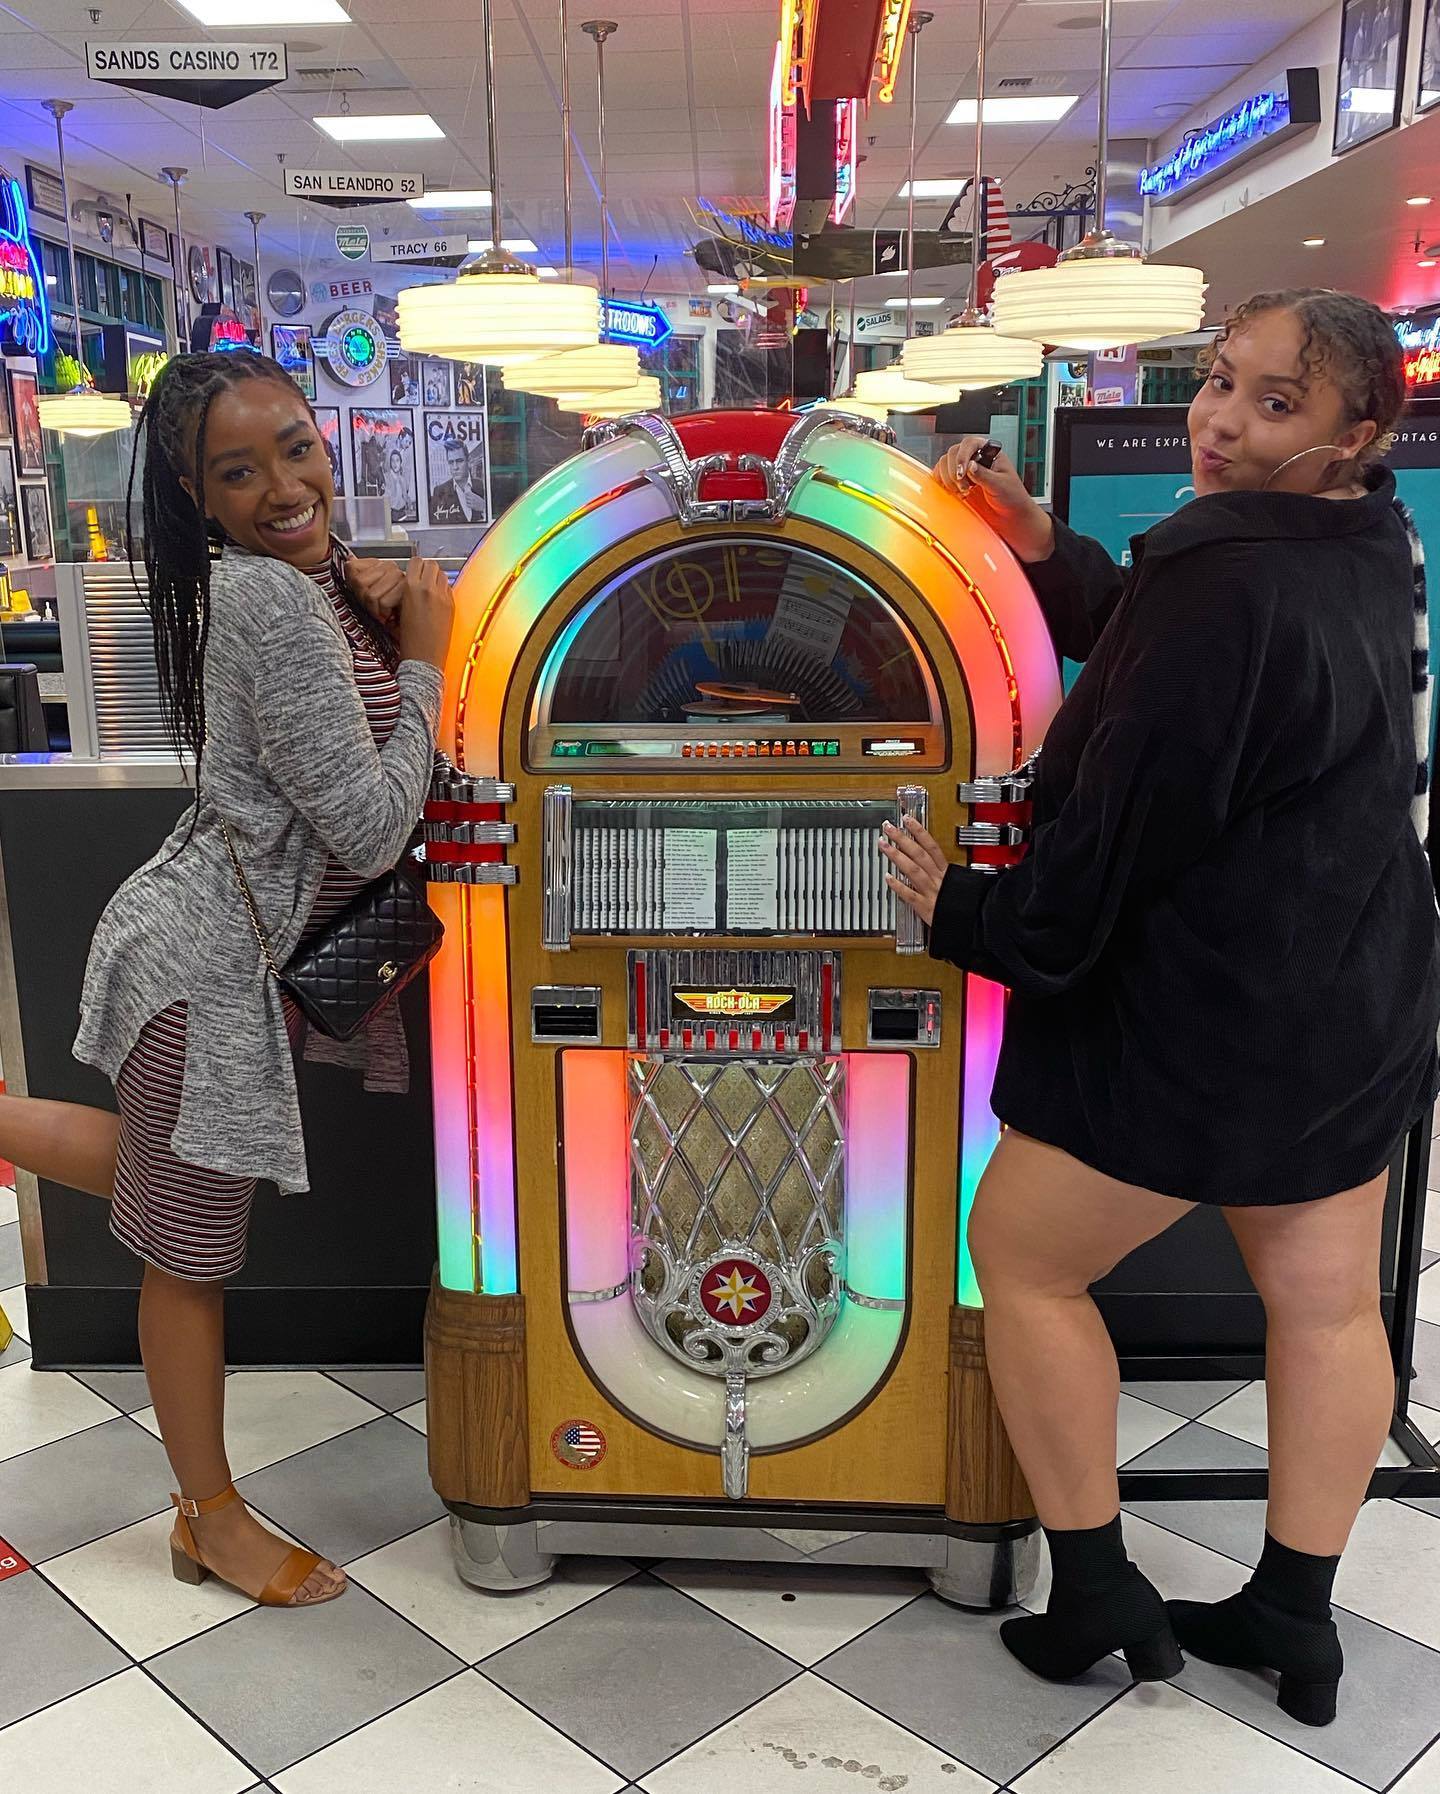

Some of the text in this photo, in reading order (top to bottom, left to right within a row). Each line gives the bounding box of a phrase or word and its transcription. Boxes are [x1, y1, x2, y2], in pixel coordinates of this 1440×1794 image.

[95, 50, 279, 71] SANDS CASINO 172
[294, 175, 416, 193] SAN LEANDRO 52
[390, 241, 448, 256] TRACY 66
[329, 280, 373, 297] BEER
[865, 313, 892, 327] SALADS
[428, 420, 481, 441] CASH
[1096, 438, 1115, 449] WE
[1122, 438, 1148, 448] ARE
